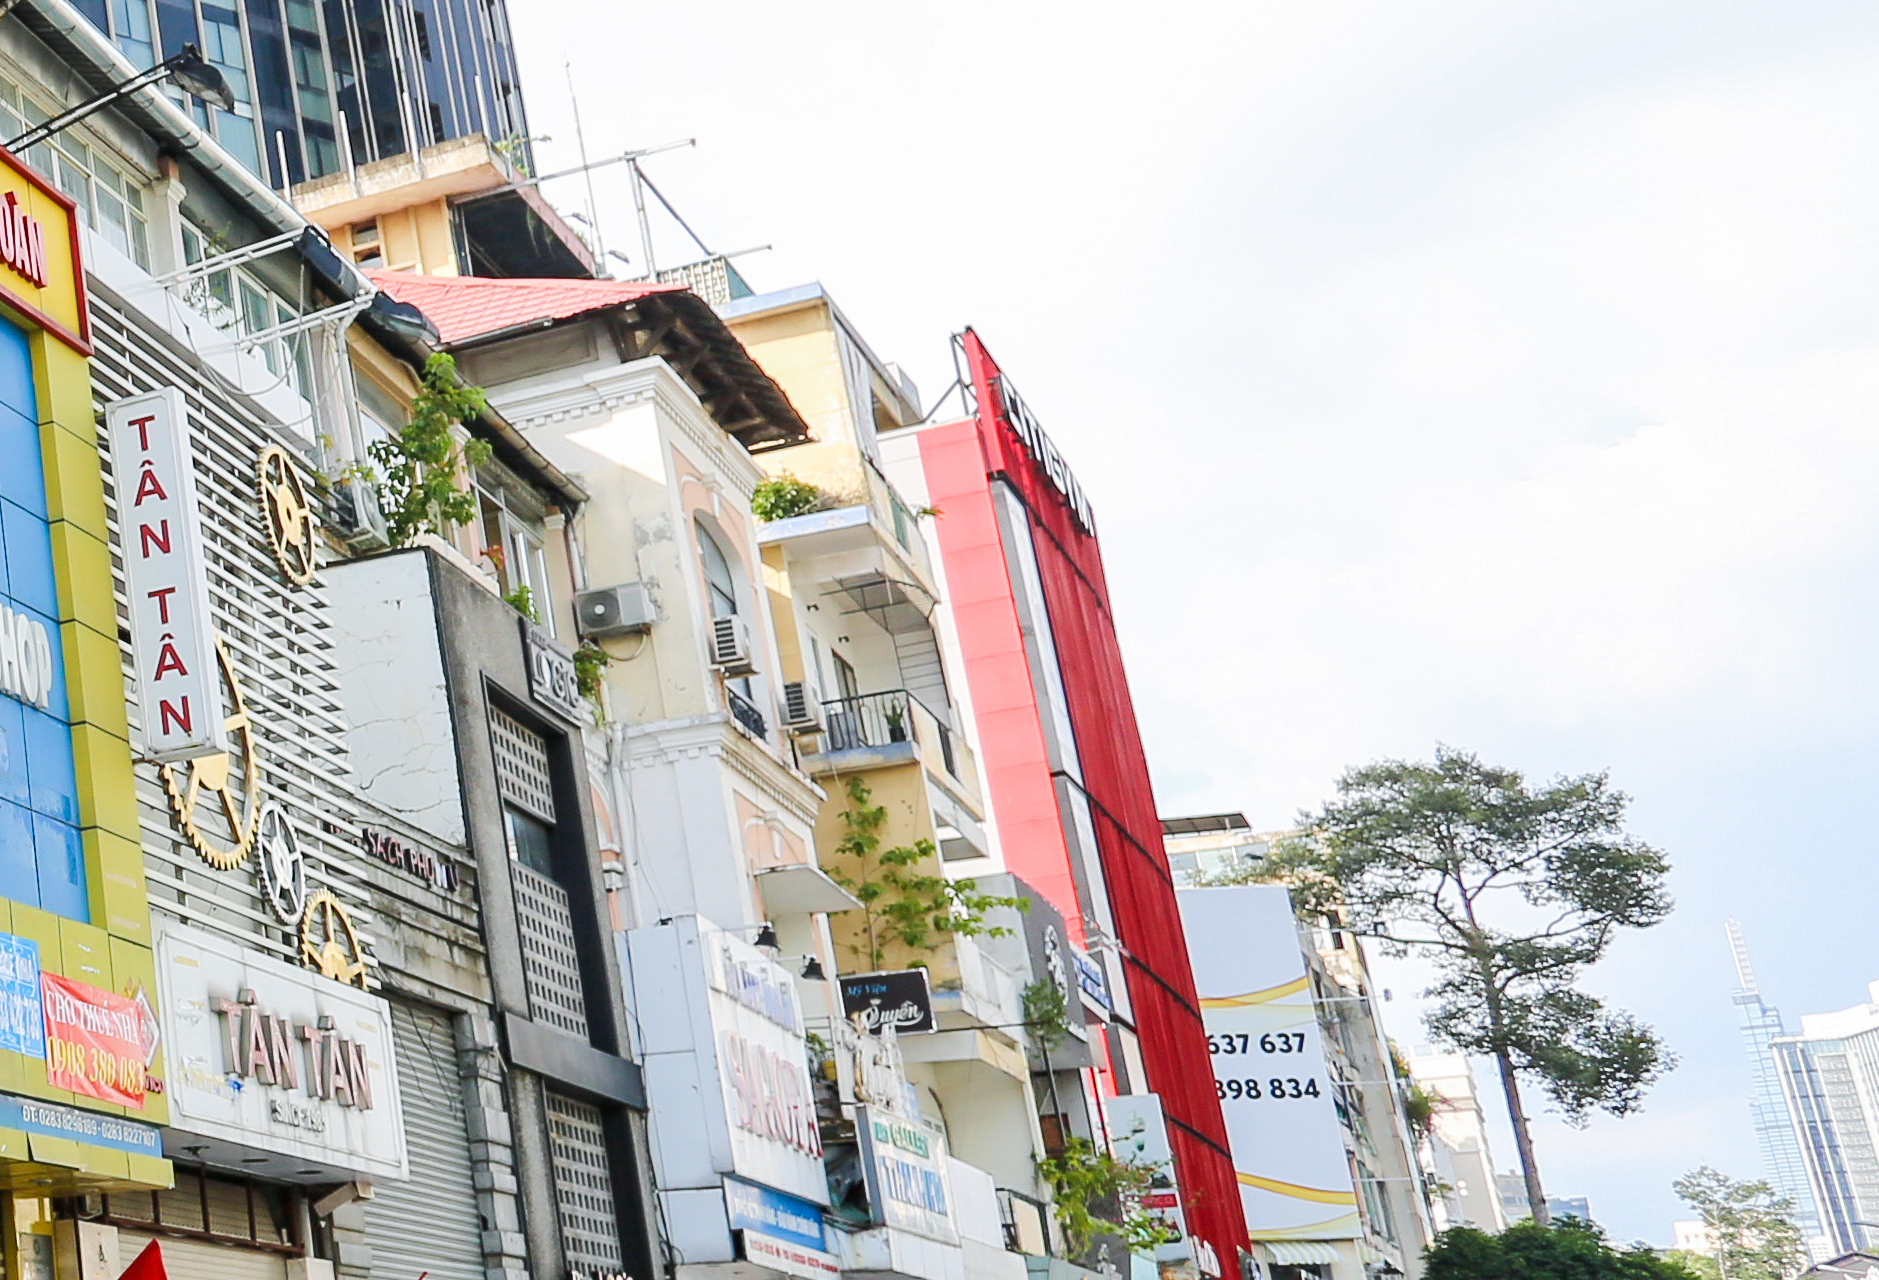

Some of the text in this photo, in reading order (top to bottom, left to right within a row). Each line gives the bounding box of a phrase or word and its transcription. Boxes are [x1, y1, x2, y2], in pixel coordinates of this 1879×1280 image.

[127, 415, 172, 559] TÂN
[147, 586, 193, 737] TÂN
[46, 990, 77, 1027] CHO
[111, 1006, 141, 1047] NHÀ
[1206, 1032, 1305, 1055] 637 637
[47, 1036, 86, 1078] 0908
[209, 988, 374, 1111] TÂN TÂN
[1269, 1077, 1321, 1100] 834
